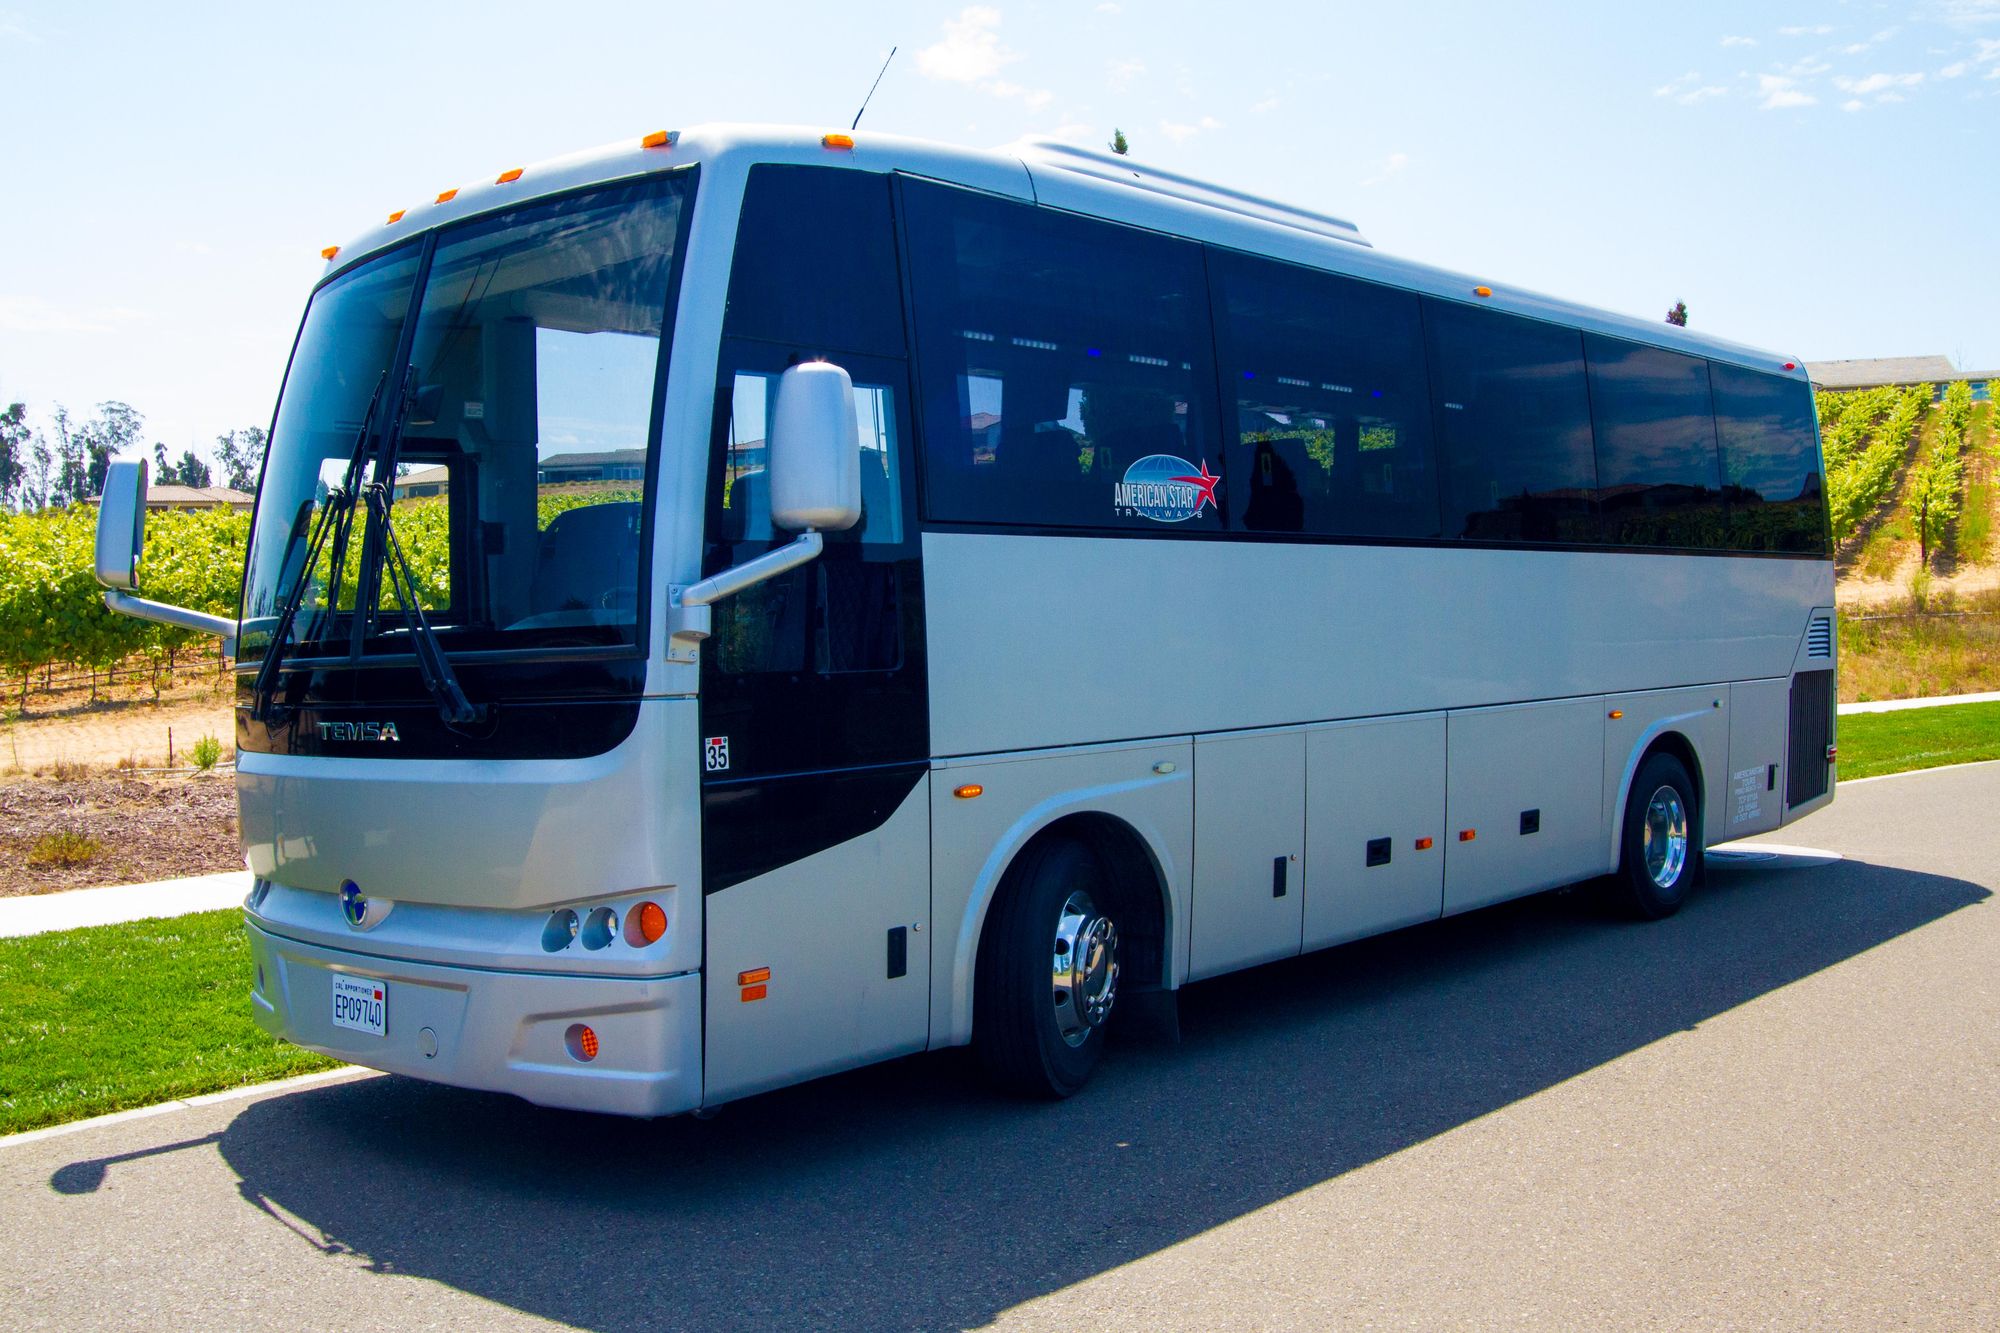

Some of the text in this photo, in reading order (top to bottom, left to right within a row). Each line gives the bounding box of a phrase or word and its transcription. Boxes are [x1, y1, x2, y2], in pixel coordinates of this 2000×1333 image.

[1114, 482, 1194, 508] AMERICAN STAR
[1115, 508, 1203, 518] TRAILWAYS
[316, 721, 400, 741] TEMSA
[708, 745, 727, 769] 35
[335, 982, 372, 996] CAL APPORTIONED
[336, 993, 381, 1027] EP09740
